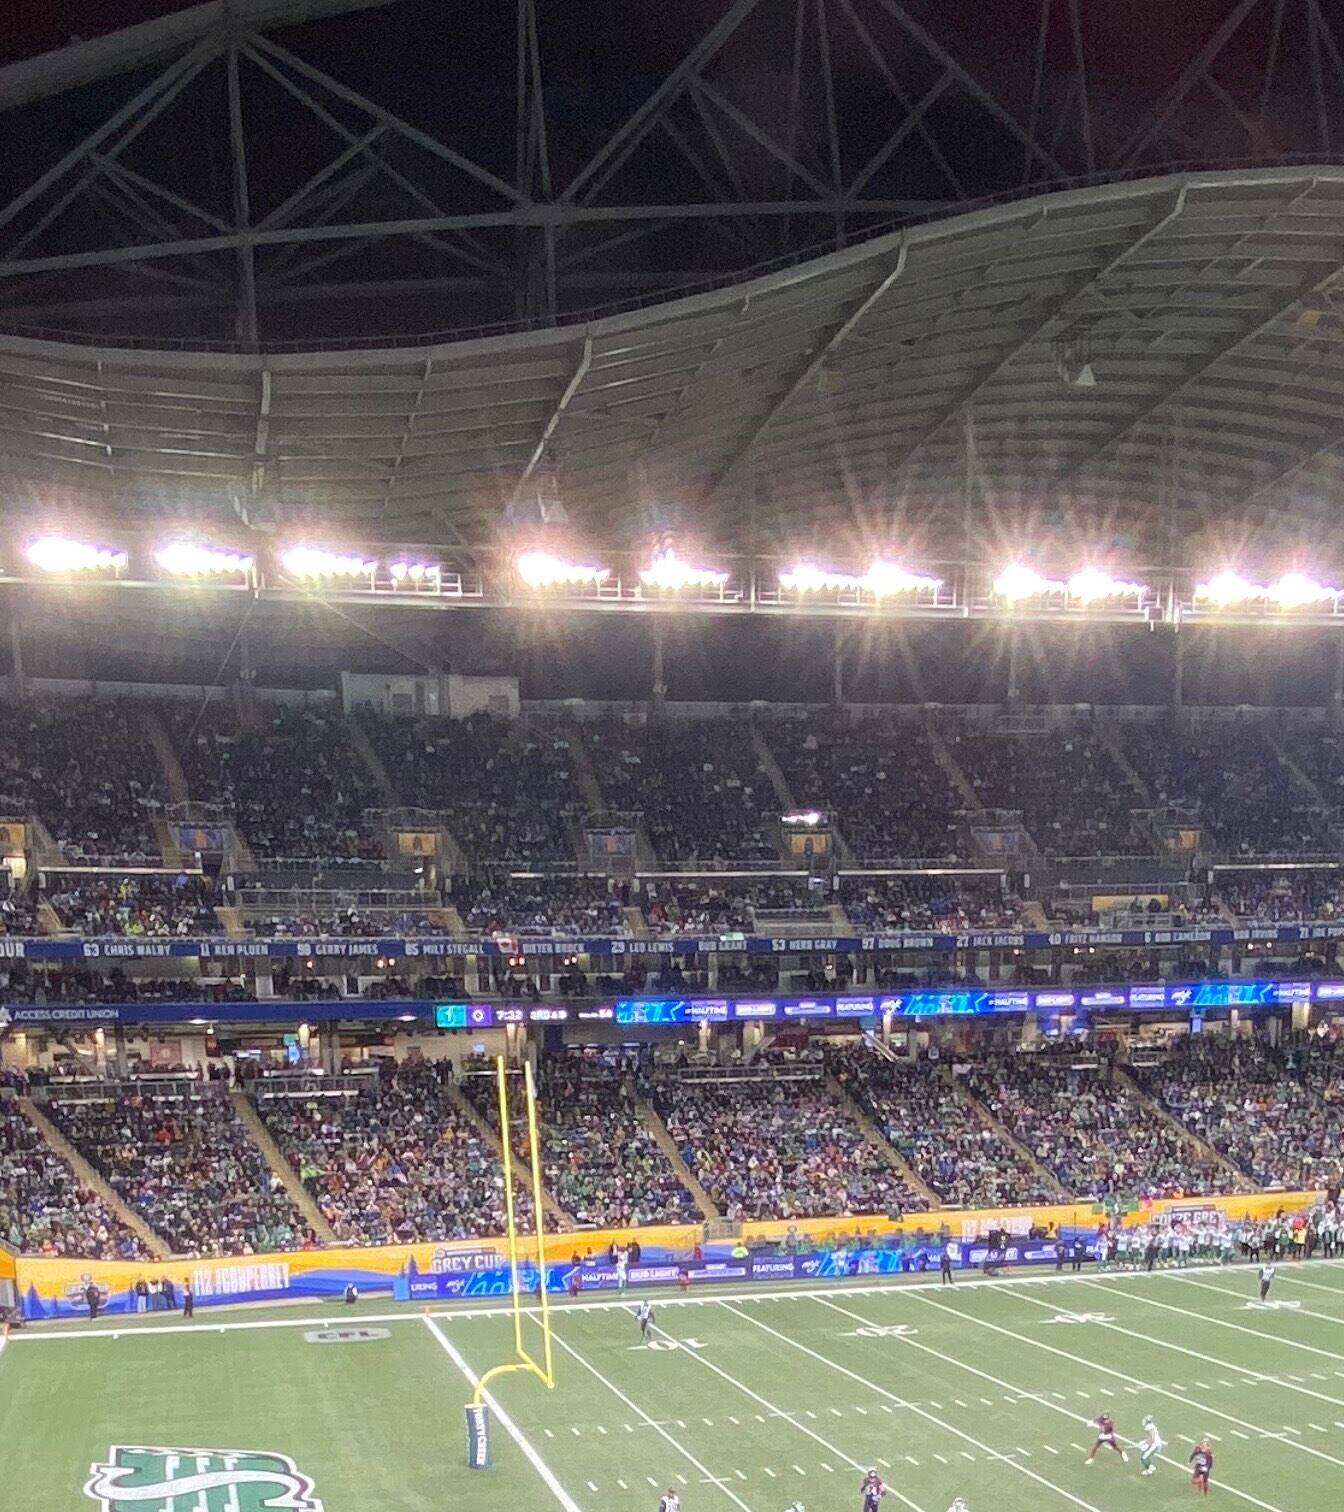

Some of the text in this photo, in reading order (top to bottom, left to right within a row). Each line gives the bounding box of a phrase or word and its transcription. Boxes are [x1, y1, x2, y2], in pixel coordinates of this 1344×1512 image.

[82, 943, 100, 957] 63
[104, 943, 135, 957] CHRIS
[433, 1253, 503, 1274] GREY CUP
[752, 1263, 794, 1274] FEATURING
